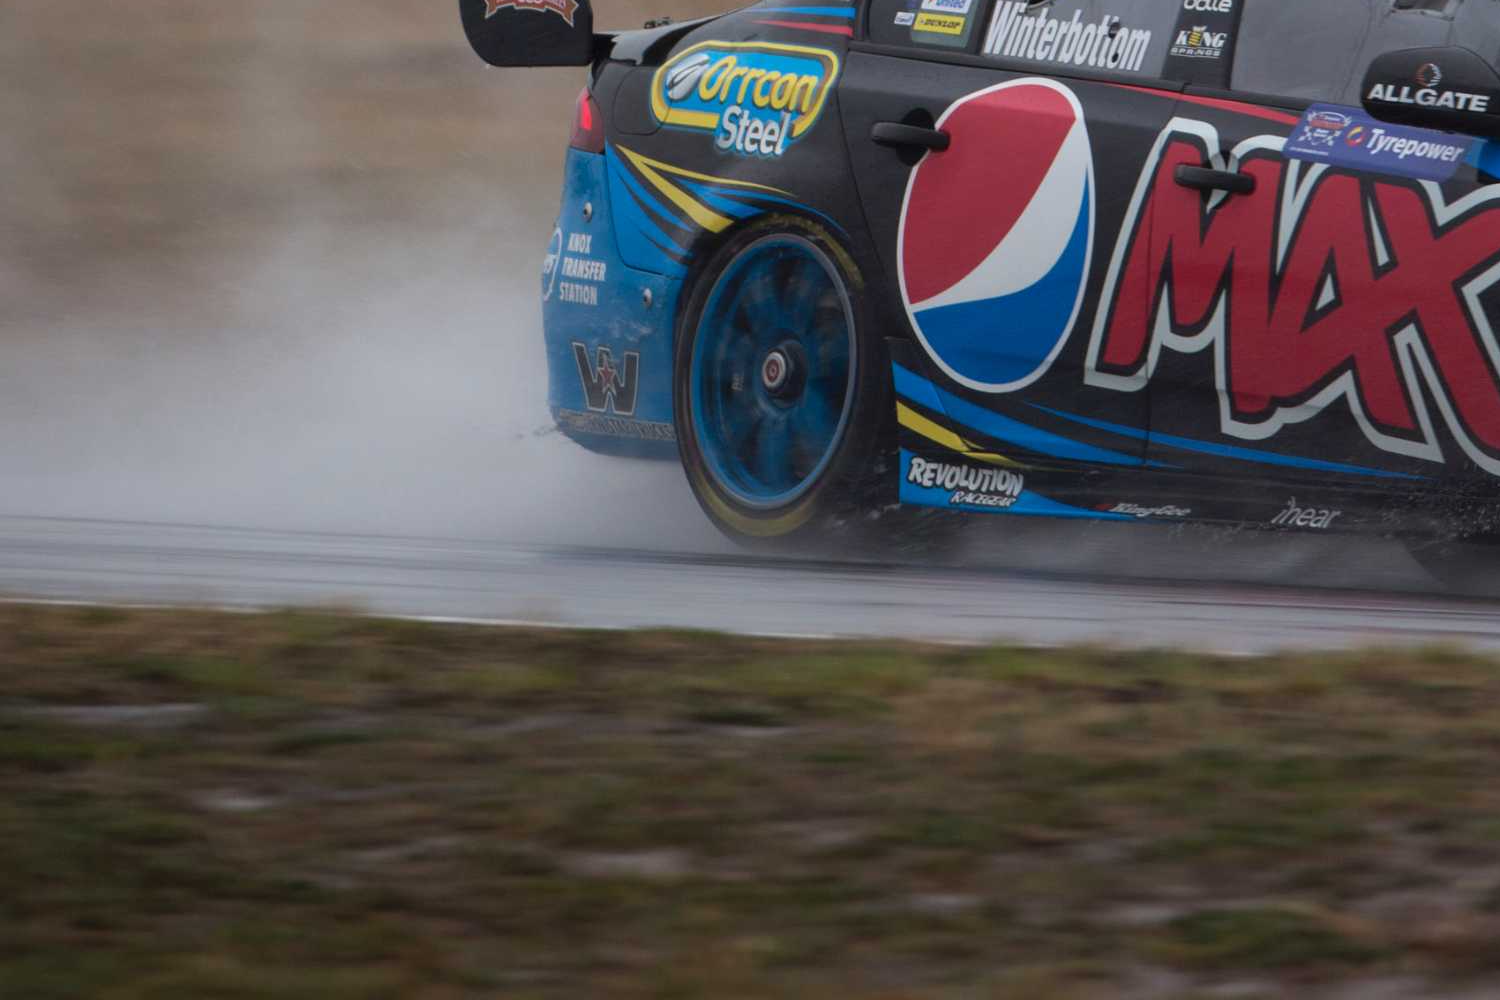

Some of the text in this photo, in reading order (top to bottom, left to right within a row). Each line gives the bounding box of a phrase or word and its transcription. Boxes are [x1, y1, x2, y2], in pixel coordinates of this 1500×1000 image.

[983, 0, 1152, 72] Winterbottom
[698, 55, 819, 114] Orrcon
[1367, 83, 1491, 113] ALLGATE
[717, 104, 792, 156] Steel
[1366, 127, 1465, 163] Tyrepower
[567, 232, 593, 255] KNOX
[560, 256, 607, 282] TRANSFER
[560, 281, 599, 306] STATION
[907, 457, 1025, 498] REVOLUTION
